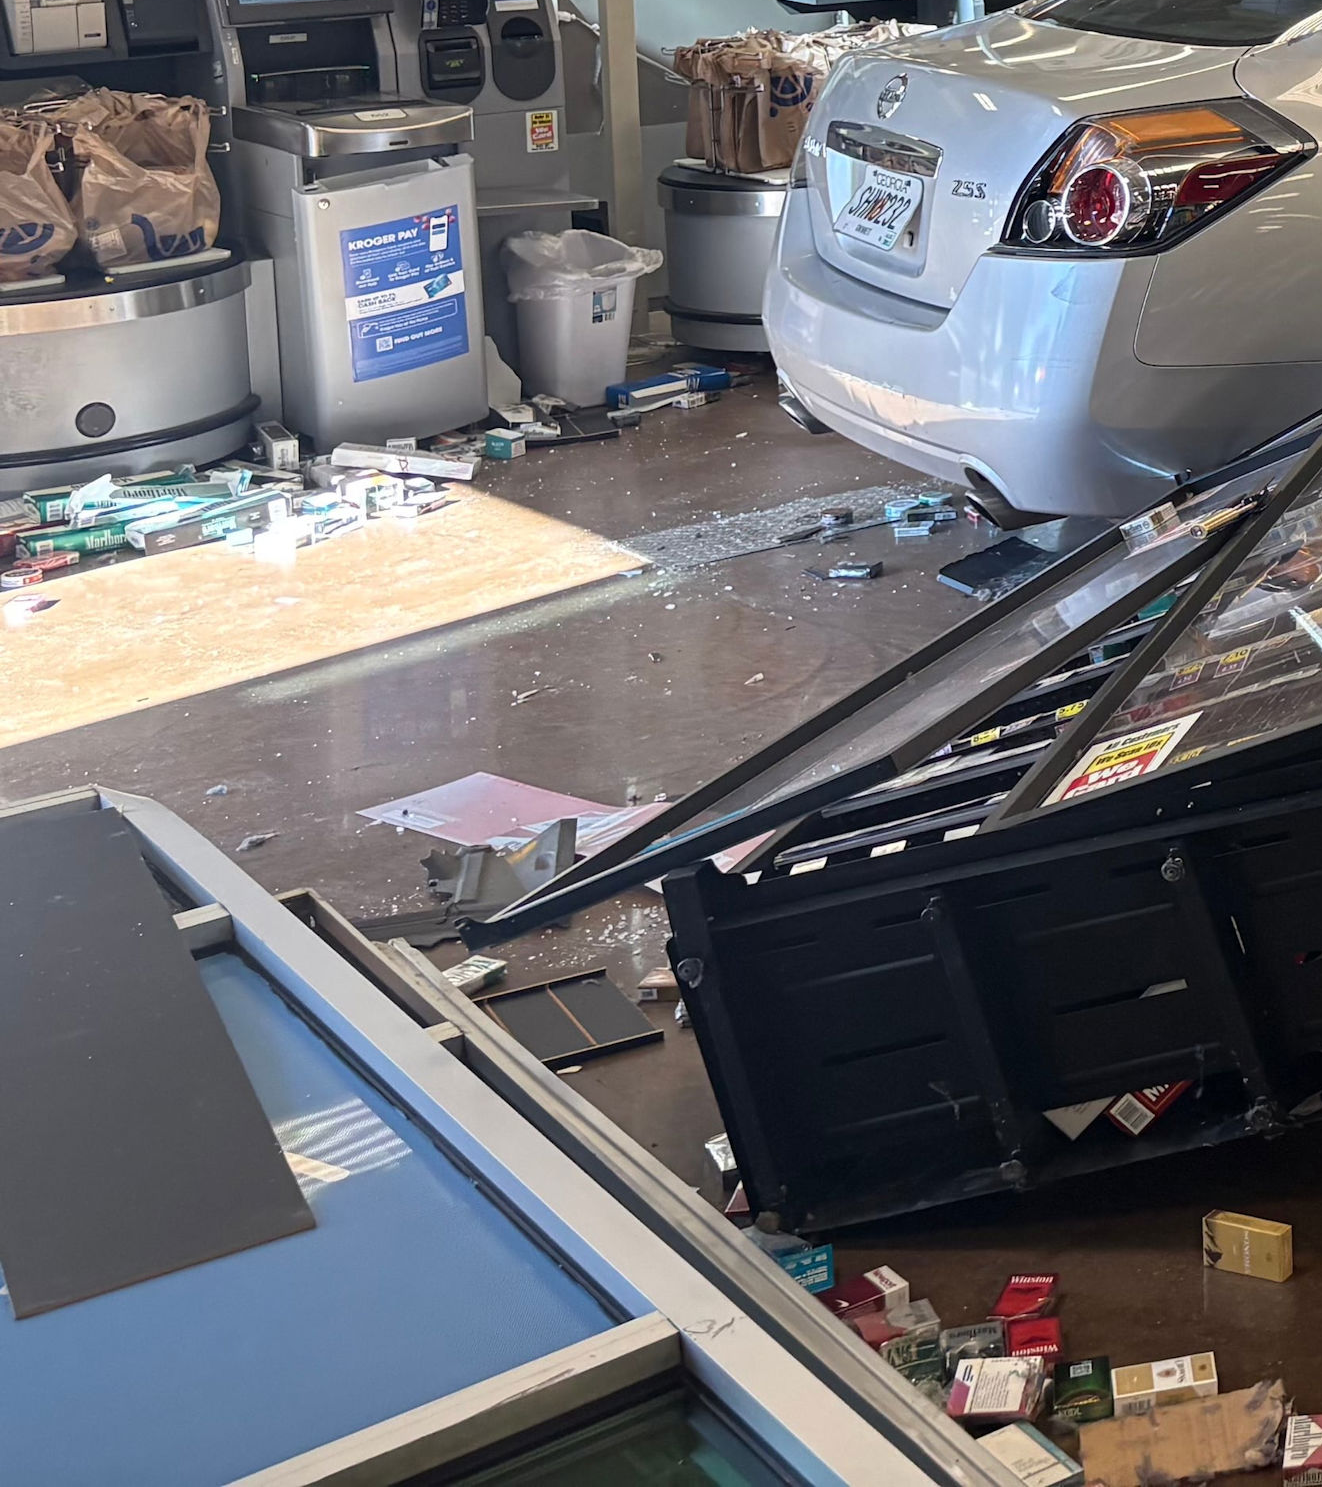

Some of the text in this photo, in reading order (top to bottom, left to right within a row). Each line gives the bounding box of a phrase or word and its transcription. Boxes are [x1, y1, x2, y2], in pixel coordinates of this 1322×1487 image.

[348, 227, 419, 251] KROGER PAY
[1123, 722, 1180, 748] Customers
[1010, 1274, 1054, 1286] Winston
[1011, 1343, 1059, 1356] Winston
